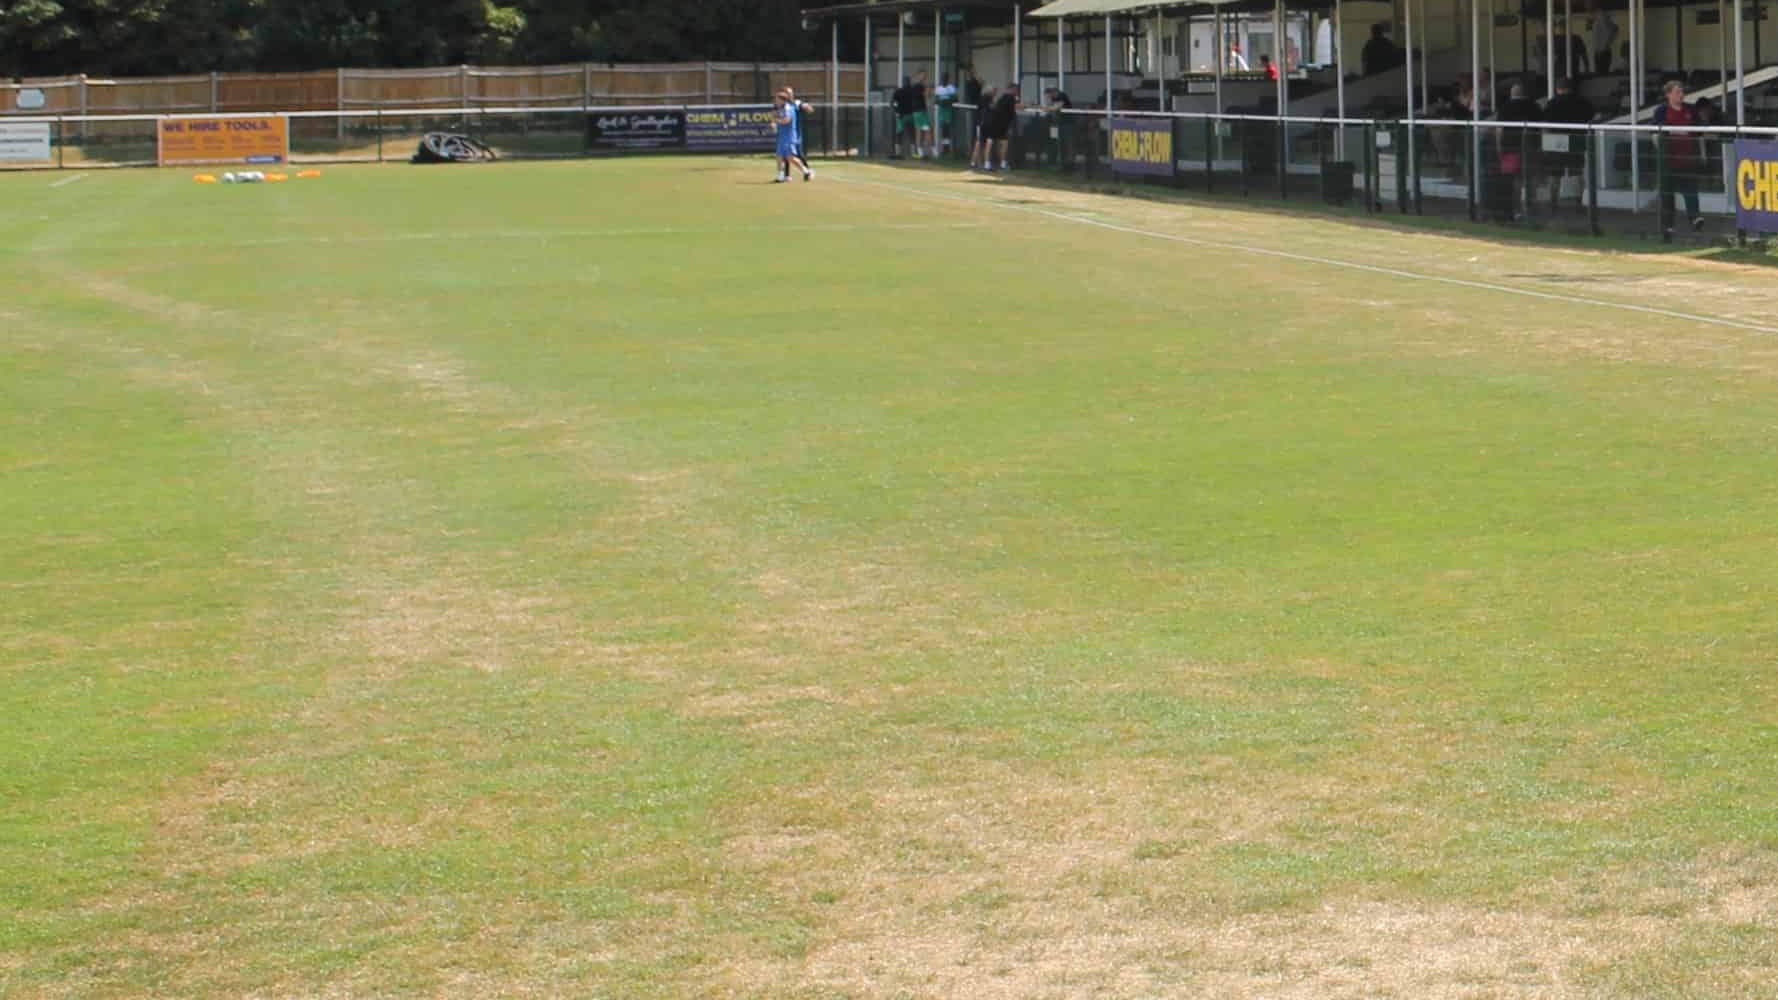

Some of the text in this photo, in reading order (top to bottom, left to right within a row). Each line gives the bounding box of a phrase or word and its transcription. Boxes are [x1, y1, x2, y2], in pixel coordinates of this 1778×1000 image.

[163, 122, 185, 131] WE
[189, 121, 219, 131] HIRE
[1111, 129, 1170, 163] CHEM FLOW
